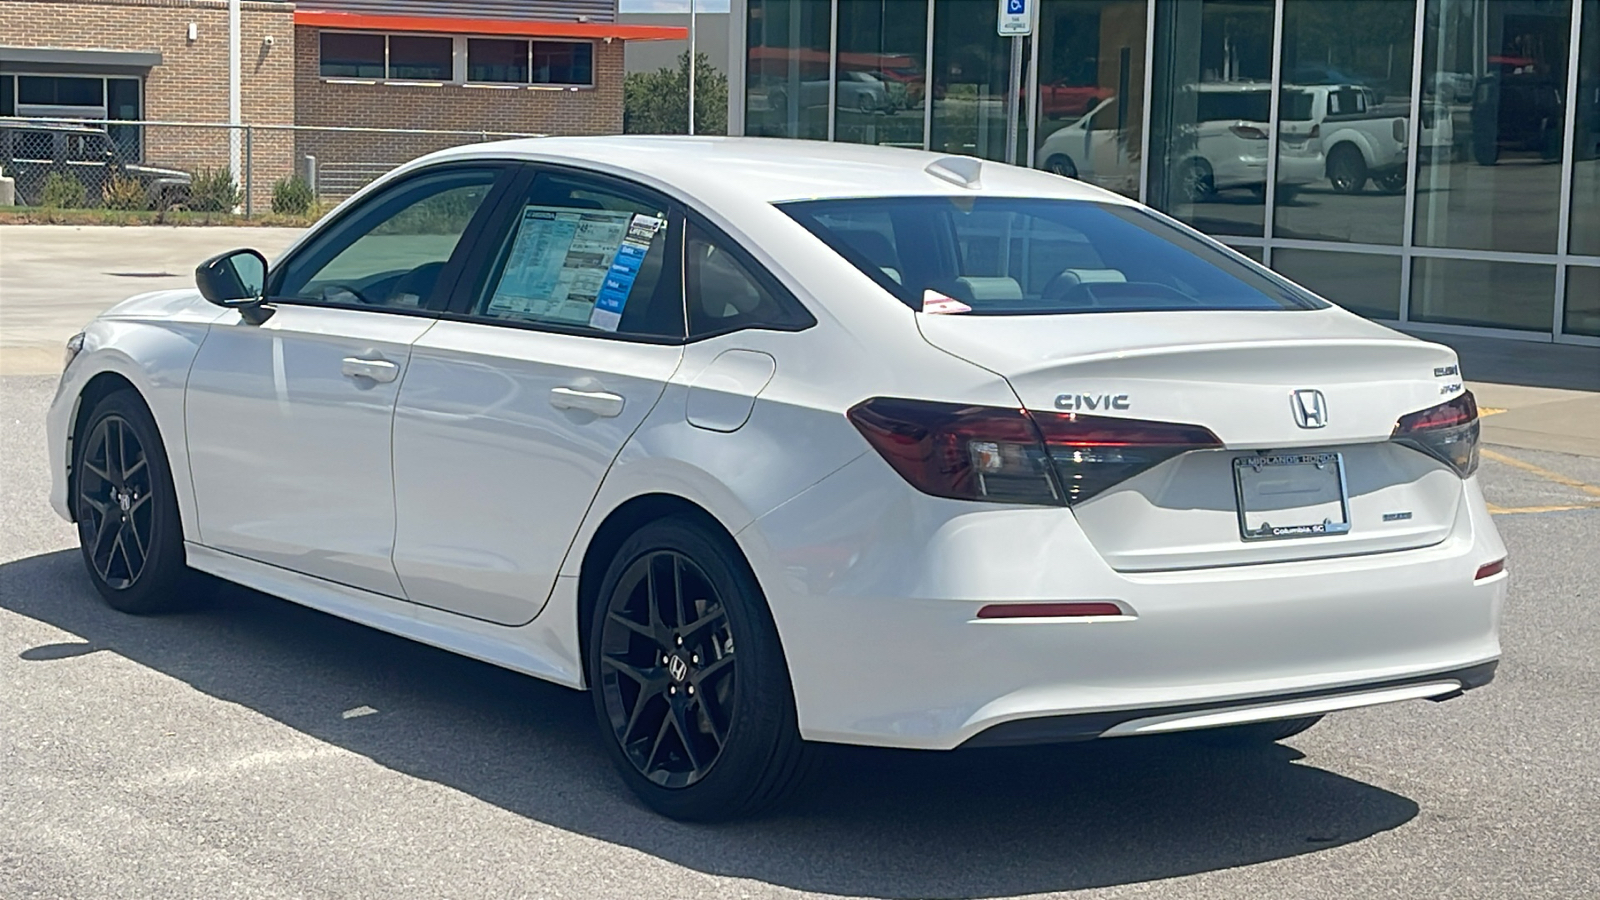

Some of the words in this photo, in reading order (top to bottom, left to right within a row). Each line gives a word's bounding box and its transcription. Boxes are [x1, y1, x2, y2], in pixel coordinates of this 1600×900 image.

[1054, 394, 1130, 410] CIVIC
[1247, 455, 1300, 466] MIDLANDS
[1302, 453, 1337, 464] HONDA
[1312, 525, 1324, 533] SC
